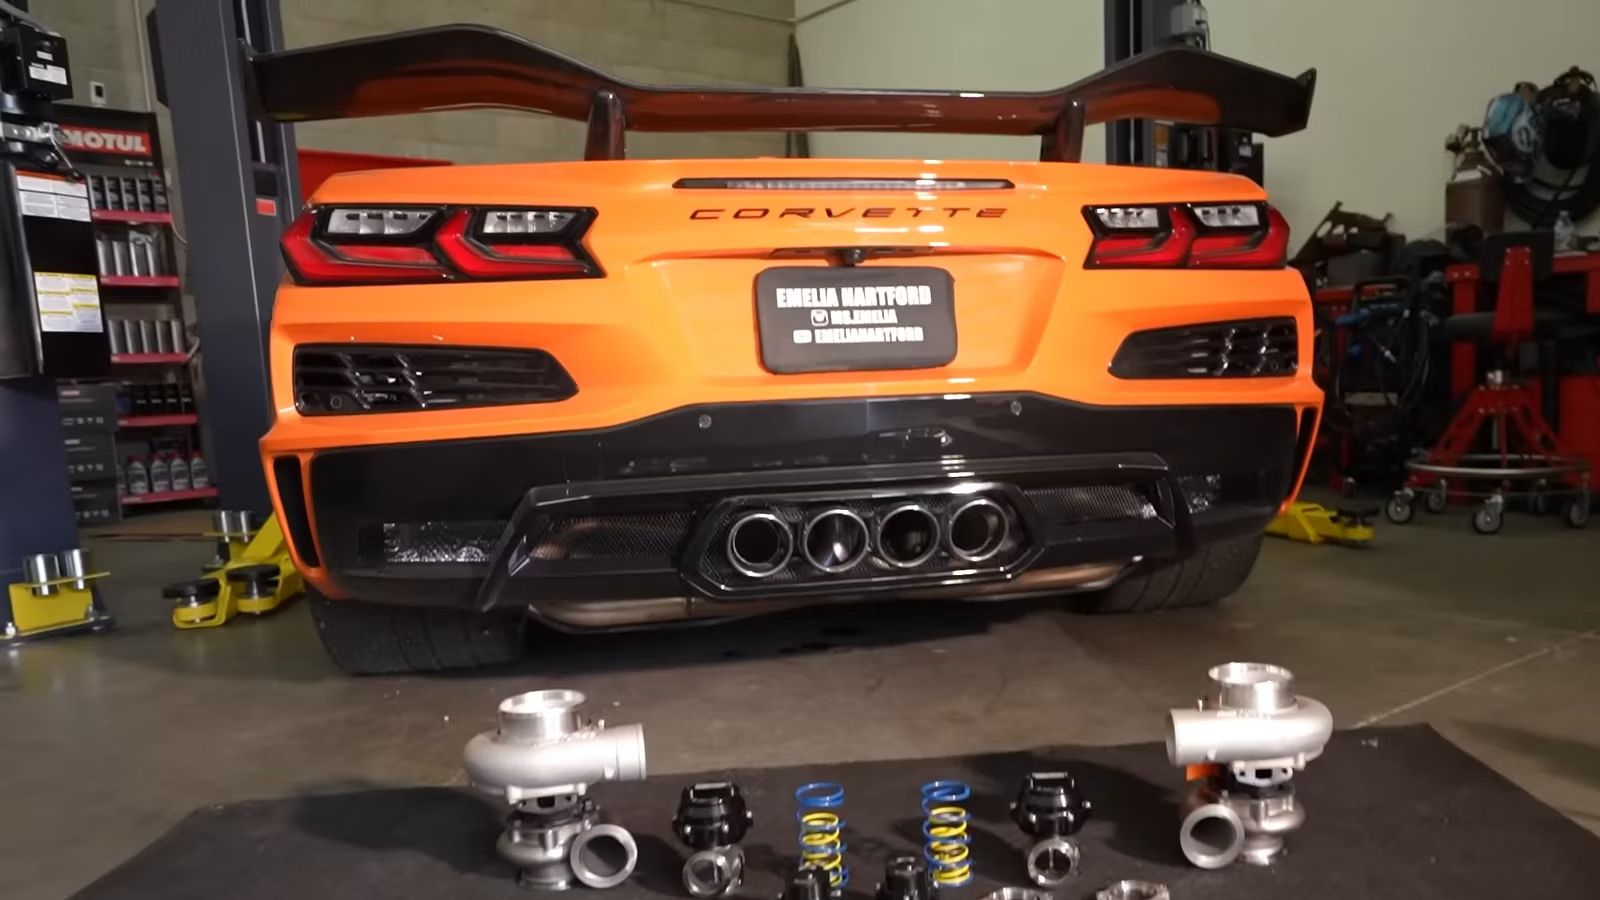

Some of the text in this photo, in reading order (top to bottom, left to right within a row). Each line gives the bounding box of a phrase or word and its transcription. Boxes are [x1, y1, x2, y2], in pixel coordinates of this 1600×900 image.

[62, 129, 147, 153] MOTUL
[689, 207, 1008, 220] CORVETTE
[776, 285, 932, 308] EMELIA HARTFORD
[830, 308, 898, 325] MS.EMELIA
[814, 326, 924, 344] EMELIAHARTFORD
